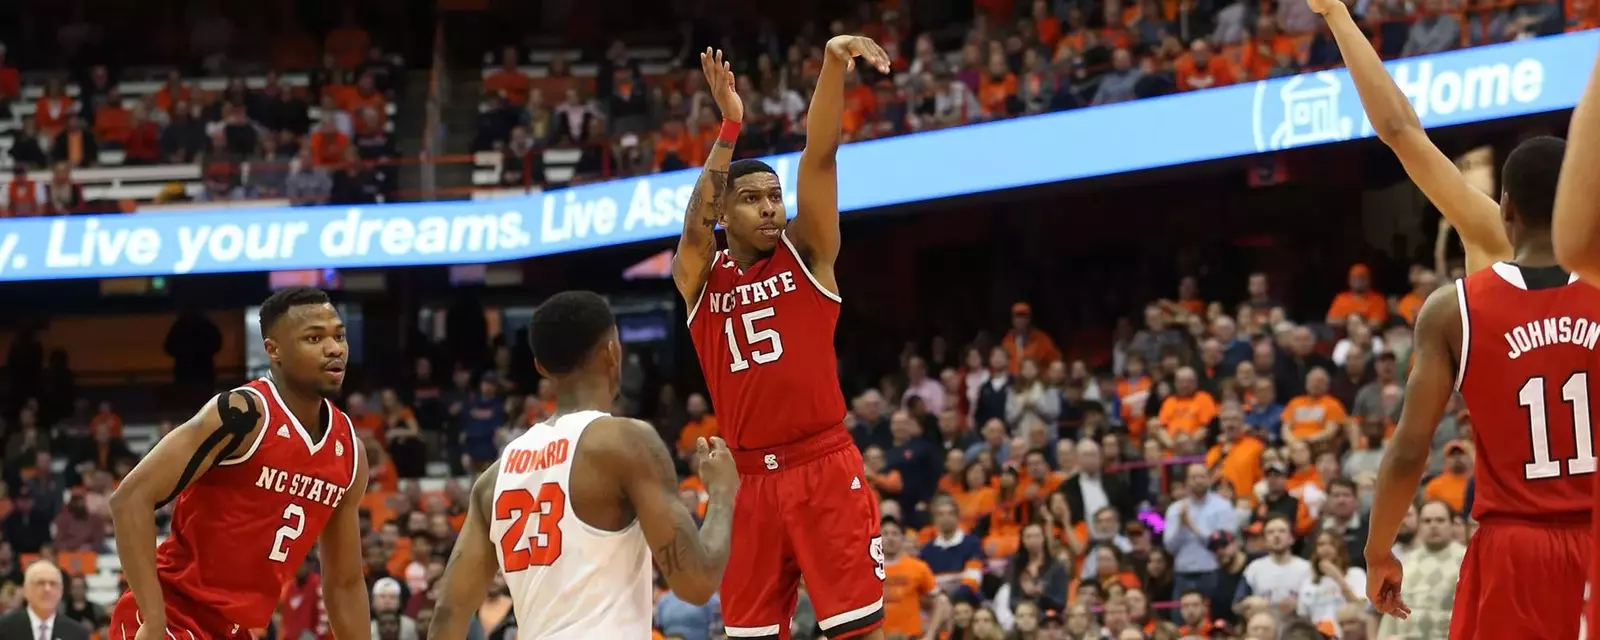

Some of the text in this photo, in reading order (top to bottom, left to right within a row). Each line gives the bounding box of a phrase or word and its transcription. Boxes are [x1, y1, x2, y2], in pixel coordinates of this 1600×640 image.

[1393, 58, 1545, 119] Home
[45, 217, 162, 269] Live
[174, 219, 309, 275] your
[319, 208, 530, 260] dreams.
[541, 189, 618, 244] Live
[723, 305, 784, 374] 15
[1504, 316, 1600, 360] JOHNSON
[1518, 371, 1599, 480] 11
[255, 465, 347, 509] NC STATE
[268, 502, 306, 563] 2
[495, 481, 566, 573] 23
